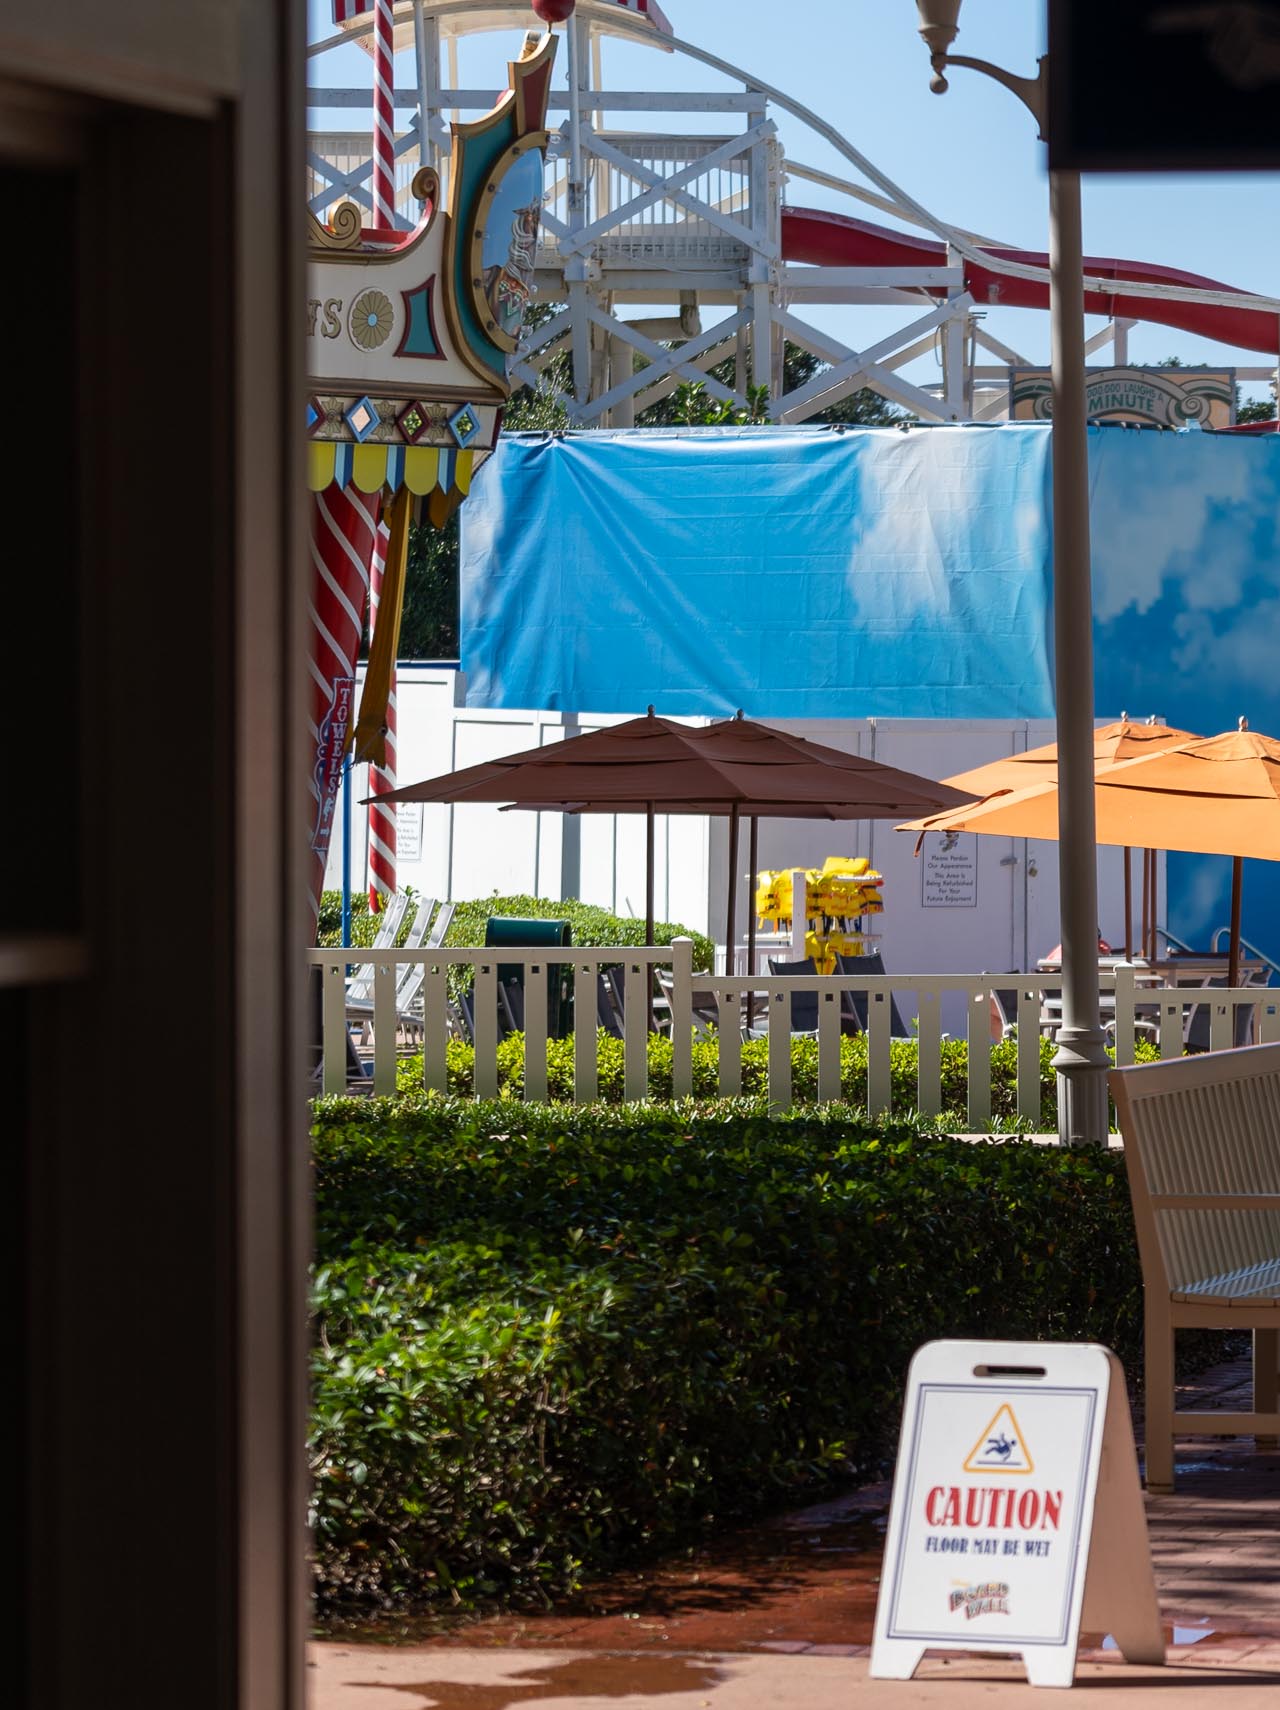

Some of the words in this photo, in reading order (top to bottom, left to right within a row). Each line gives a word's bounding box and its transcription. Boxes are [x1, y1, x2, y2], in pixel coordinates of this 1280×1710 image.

[1088, 394, 1154, 413] MINUTE
[328, 687, 351, 794] TOWELS
[925, 1486, 1063, 1530] CAUTION
[925, 1536, 968, 1553] FLOOR
[973, 1538, 999, 1555] MAY
[1003, 1539, 1020, 1556] BE
[1025, 1540, 1051, 1557] WET
